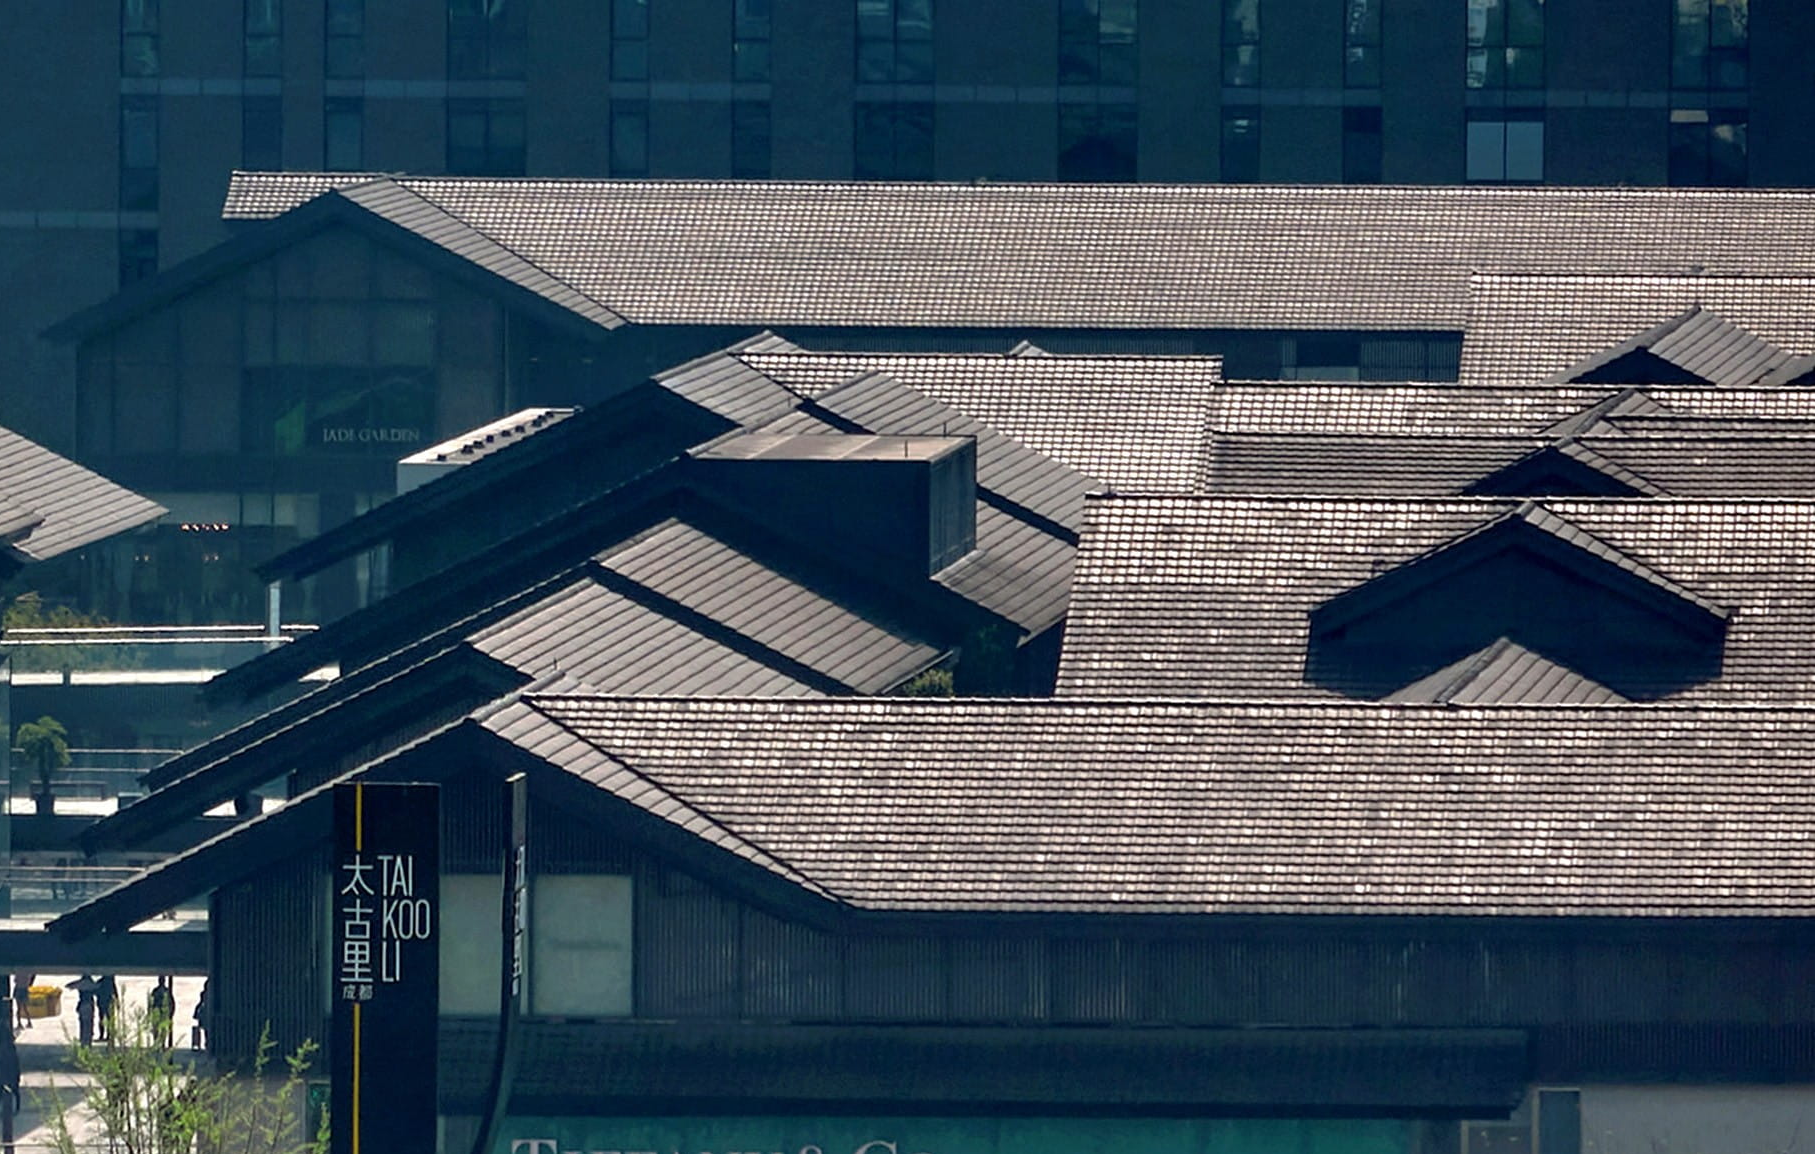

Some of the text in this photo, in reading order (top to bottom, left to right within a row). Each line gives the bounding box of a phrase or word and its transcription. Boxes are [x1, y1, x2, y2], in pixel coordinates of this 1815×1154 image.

[377, 855, 413, 897] TAI
[340, 854, 375, 984] 太古里
[381, 899, 431, 940] KOO
[381, 939, 401, 983] LI
